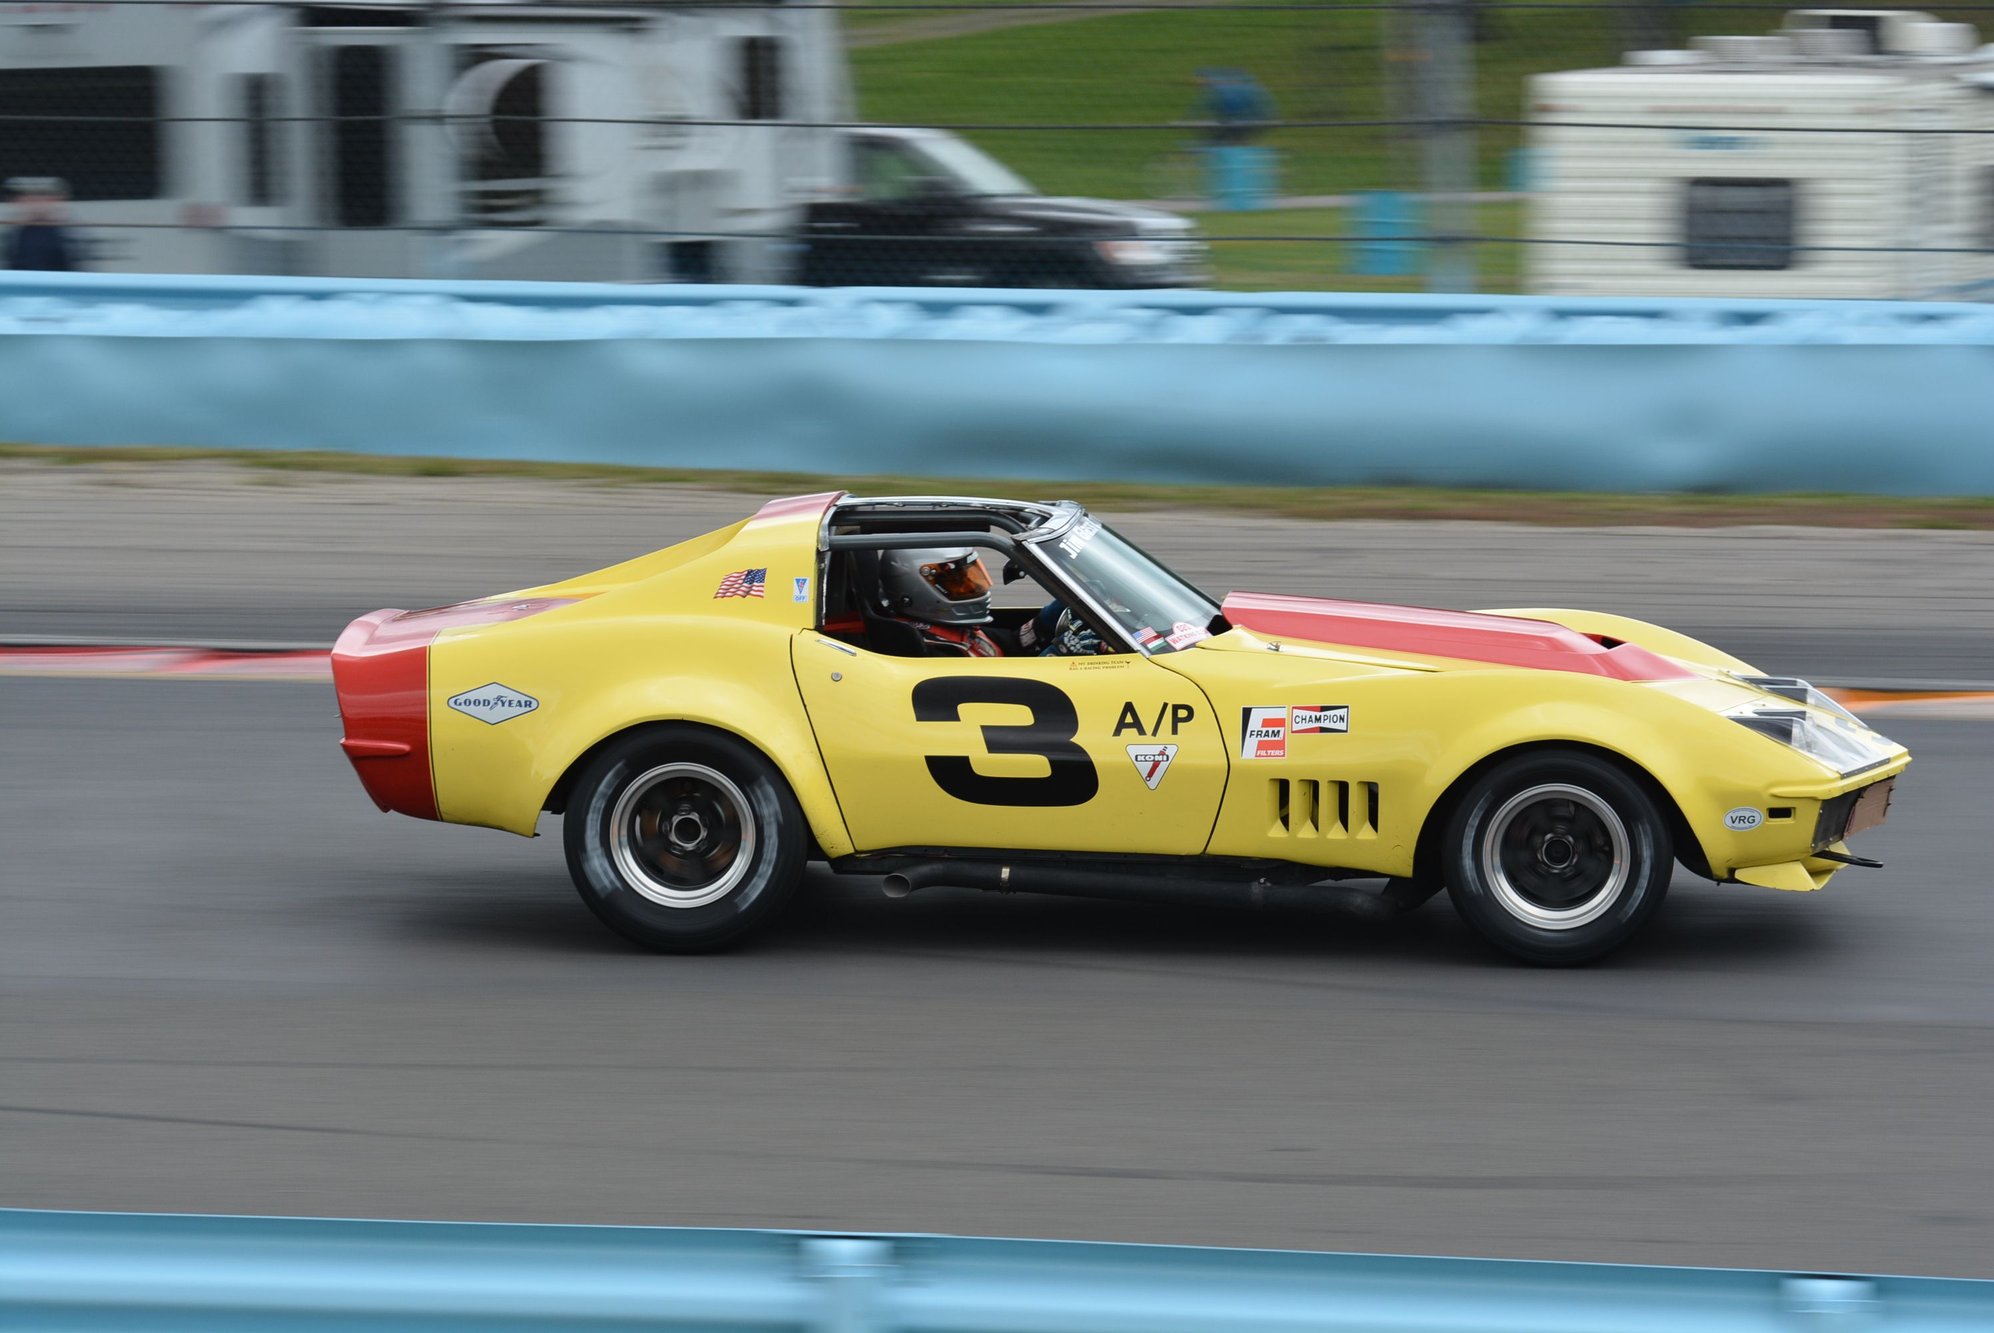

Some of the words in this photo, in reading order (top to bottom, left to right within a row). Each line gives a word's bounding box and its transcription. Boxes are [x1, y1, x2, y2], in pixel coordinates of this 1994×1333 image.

[1112, 701, 1195, 737] A/P
[1294, 714, 1346, 725] CHAMPION
[1249, 729, 1281, 739] FRAM
[911, 675, 1099, 807] 3
[1136, 754, 1168, 762] KONI
[1256, 749, 1284, 757] FILTERS
[1730, 815, 1756, 824] VRG
